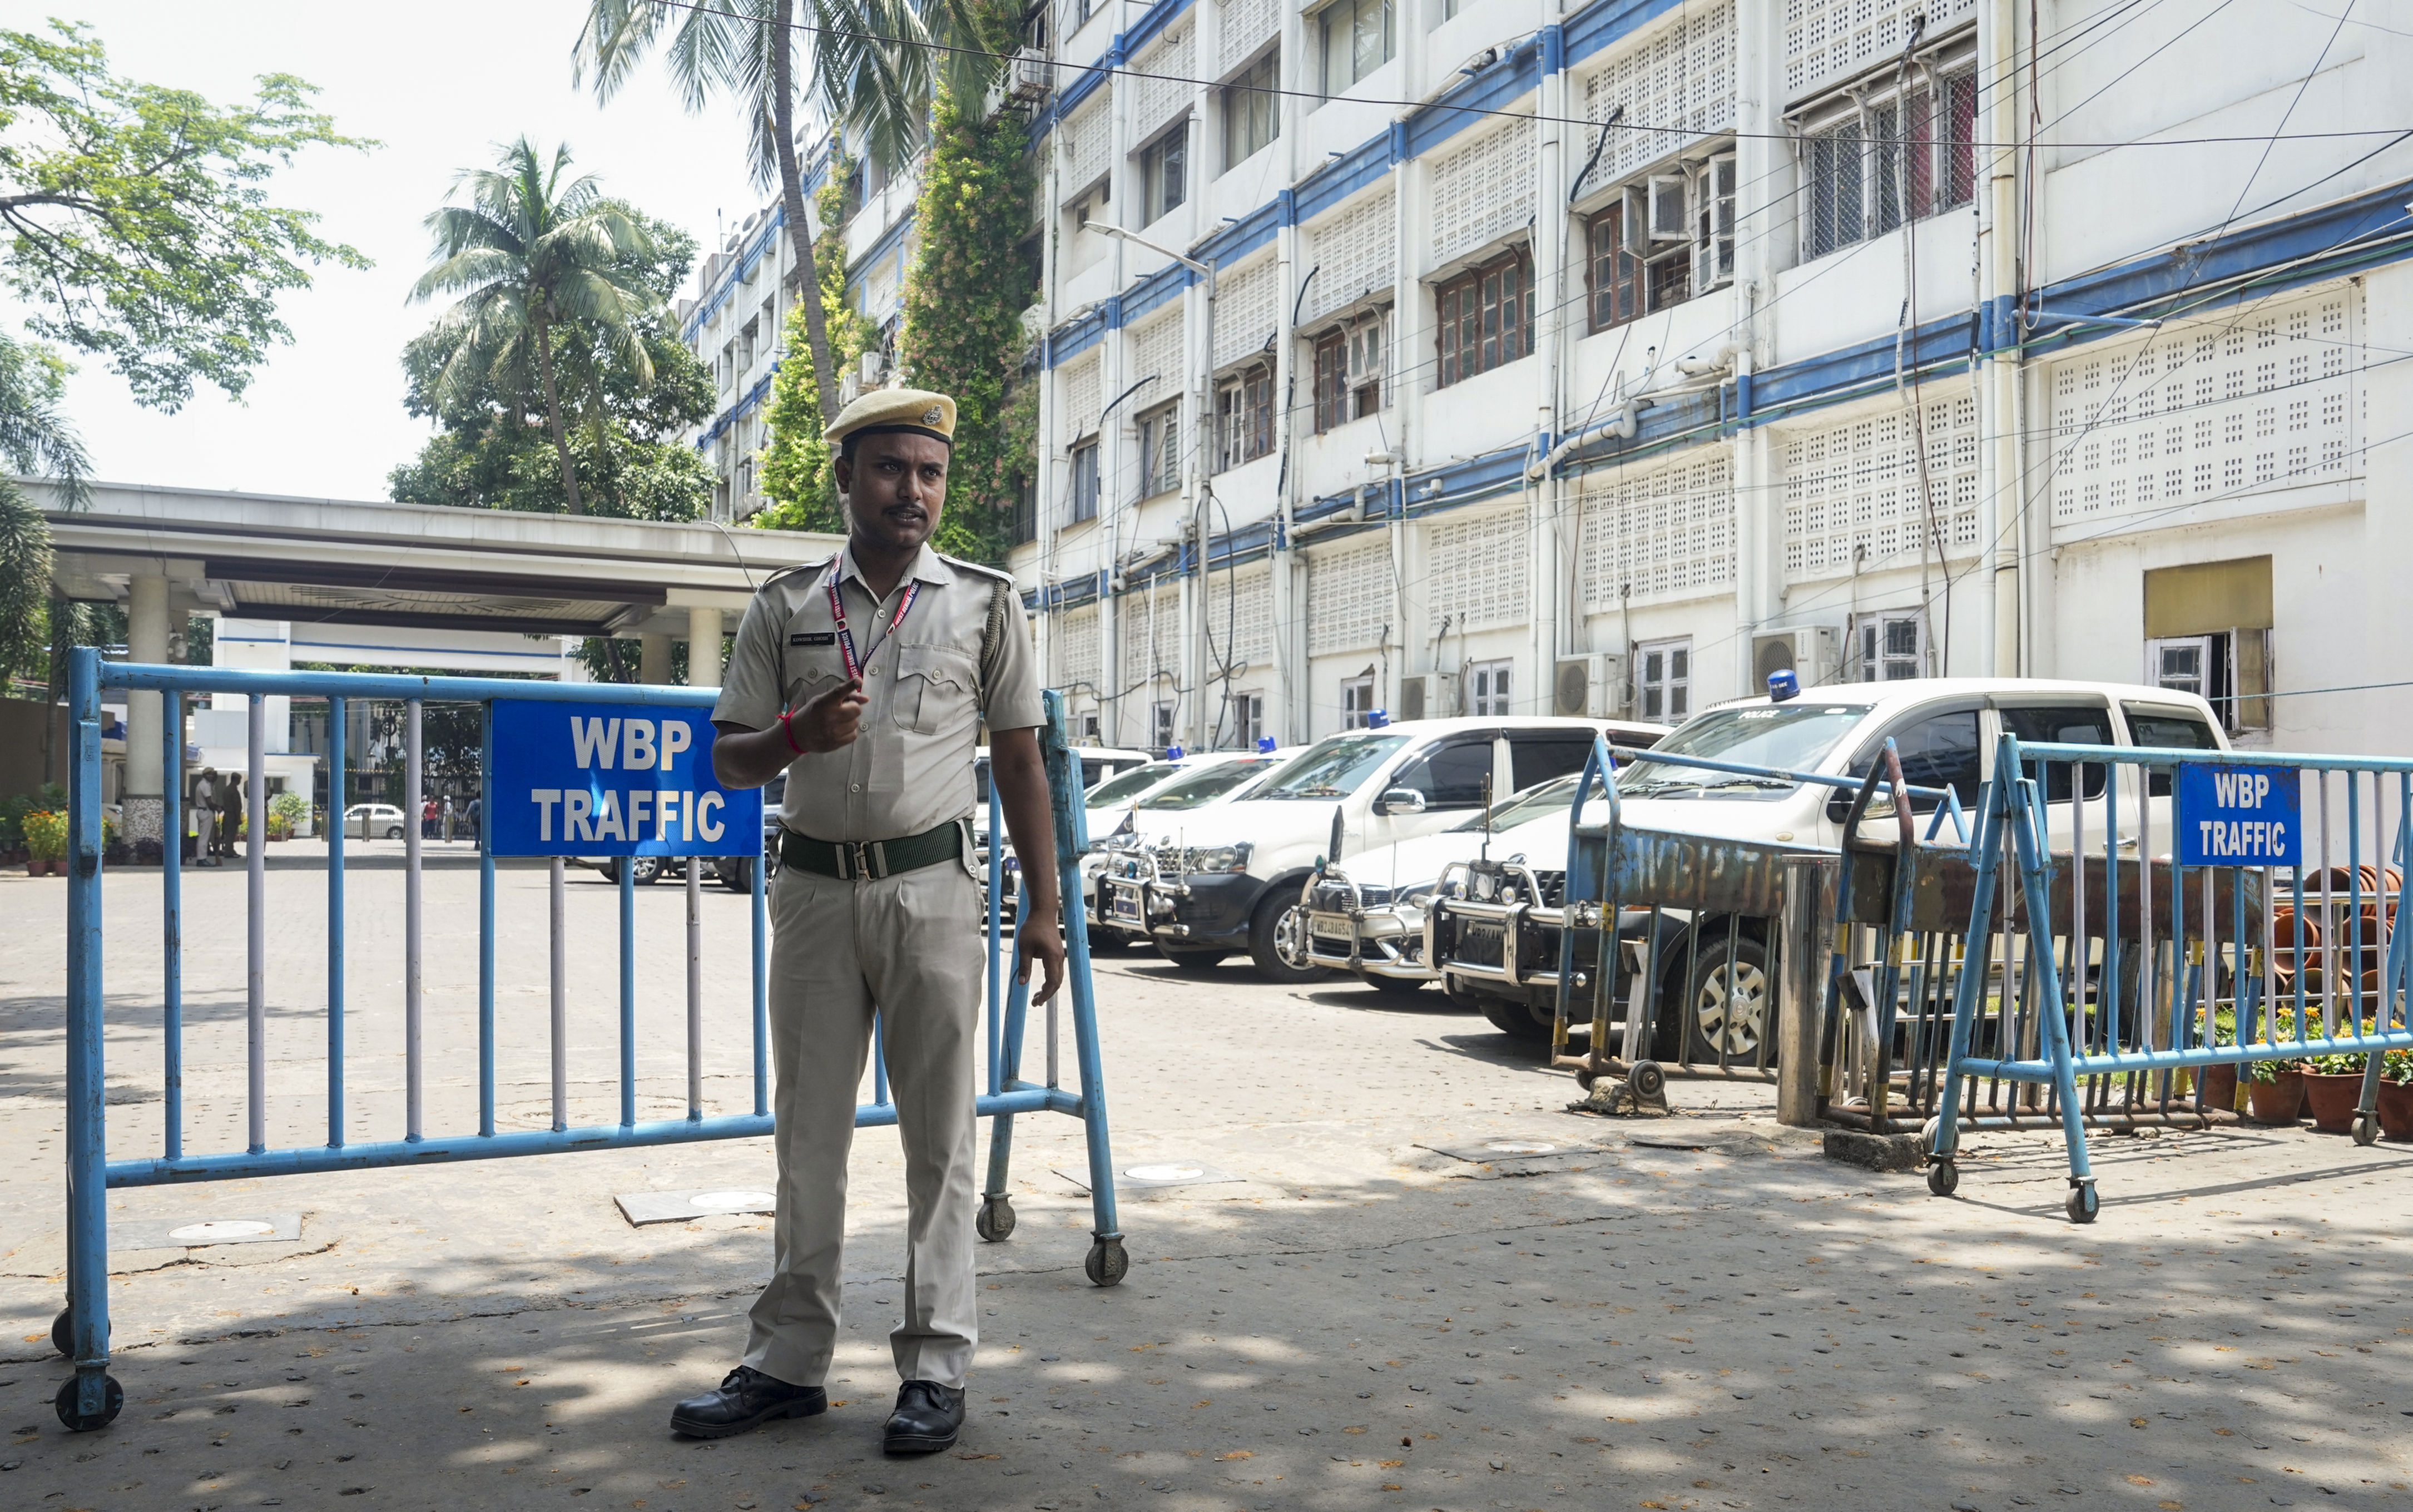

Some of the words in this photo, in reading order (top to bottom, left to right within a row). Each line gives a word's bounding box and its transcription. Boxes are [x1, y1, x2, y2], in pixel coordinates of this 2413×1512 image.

[895, 612, 904, 626] WEST
[901, 596, 913, 613] BENGAL
[841, 632, 851, 650] POLICE
[1738, 710, 1780, 719] POLICE
[570, 716, 692, 771] WBP
[2214, 772, 2270, 809] WBP
[531, 789, 725, 842] TRAFFIC
[2199, 821, 2286, 857] TRAFFIC
[1635, 837, 1727, 904] WBP
